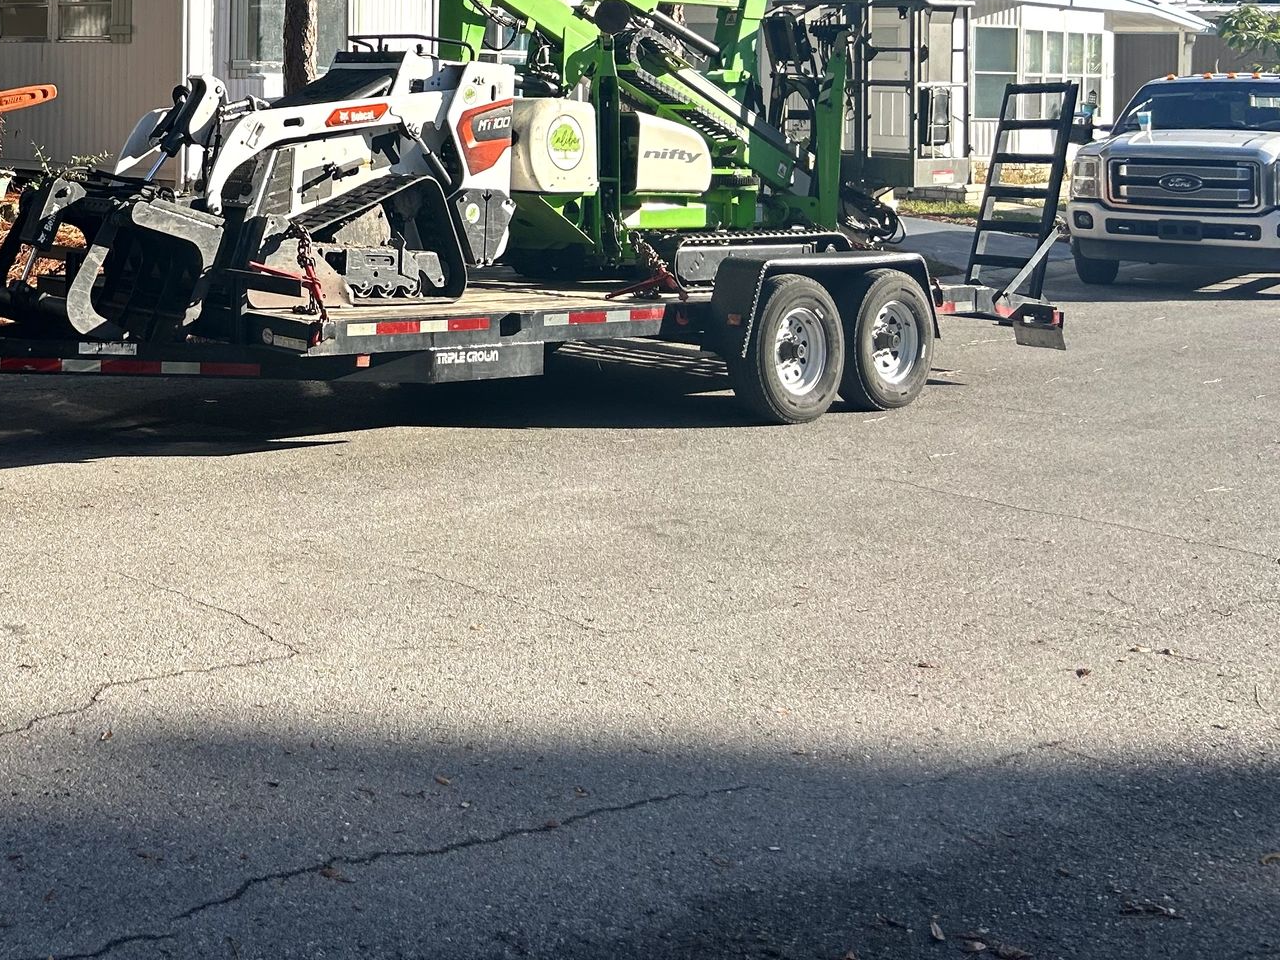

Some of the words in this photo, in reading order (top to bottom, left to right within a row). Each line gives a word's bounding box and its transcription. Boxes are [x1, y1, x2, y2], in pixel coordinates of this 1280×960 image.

[643, 147, 703, 164] nifty
[436, 352, 466, 365] TRIPLE
[466, 350, 499, 363] CROWN
